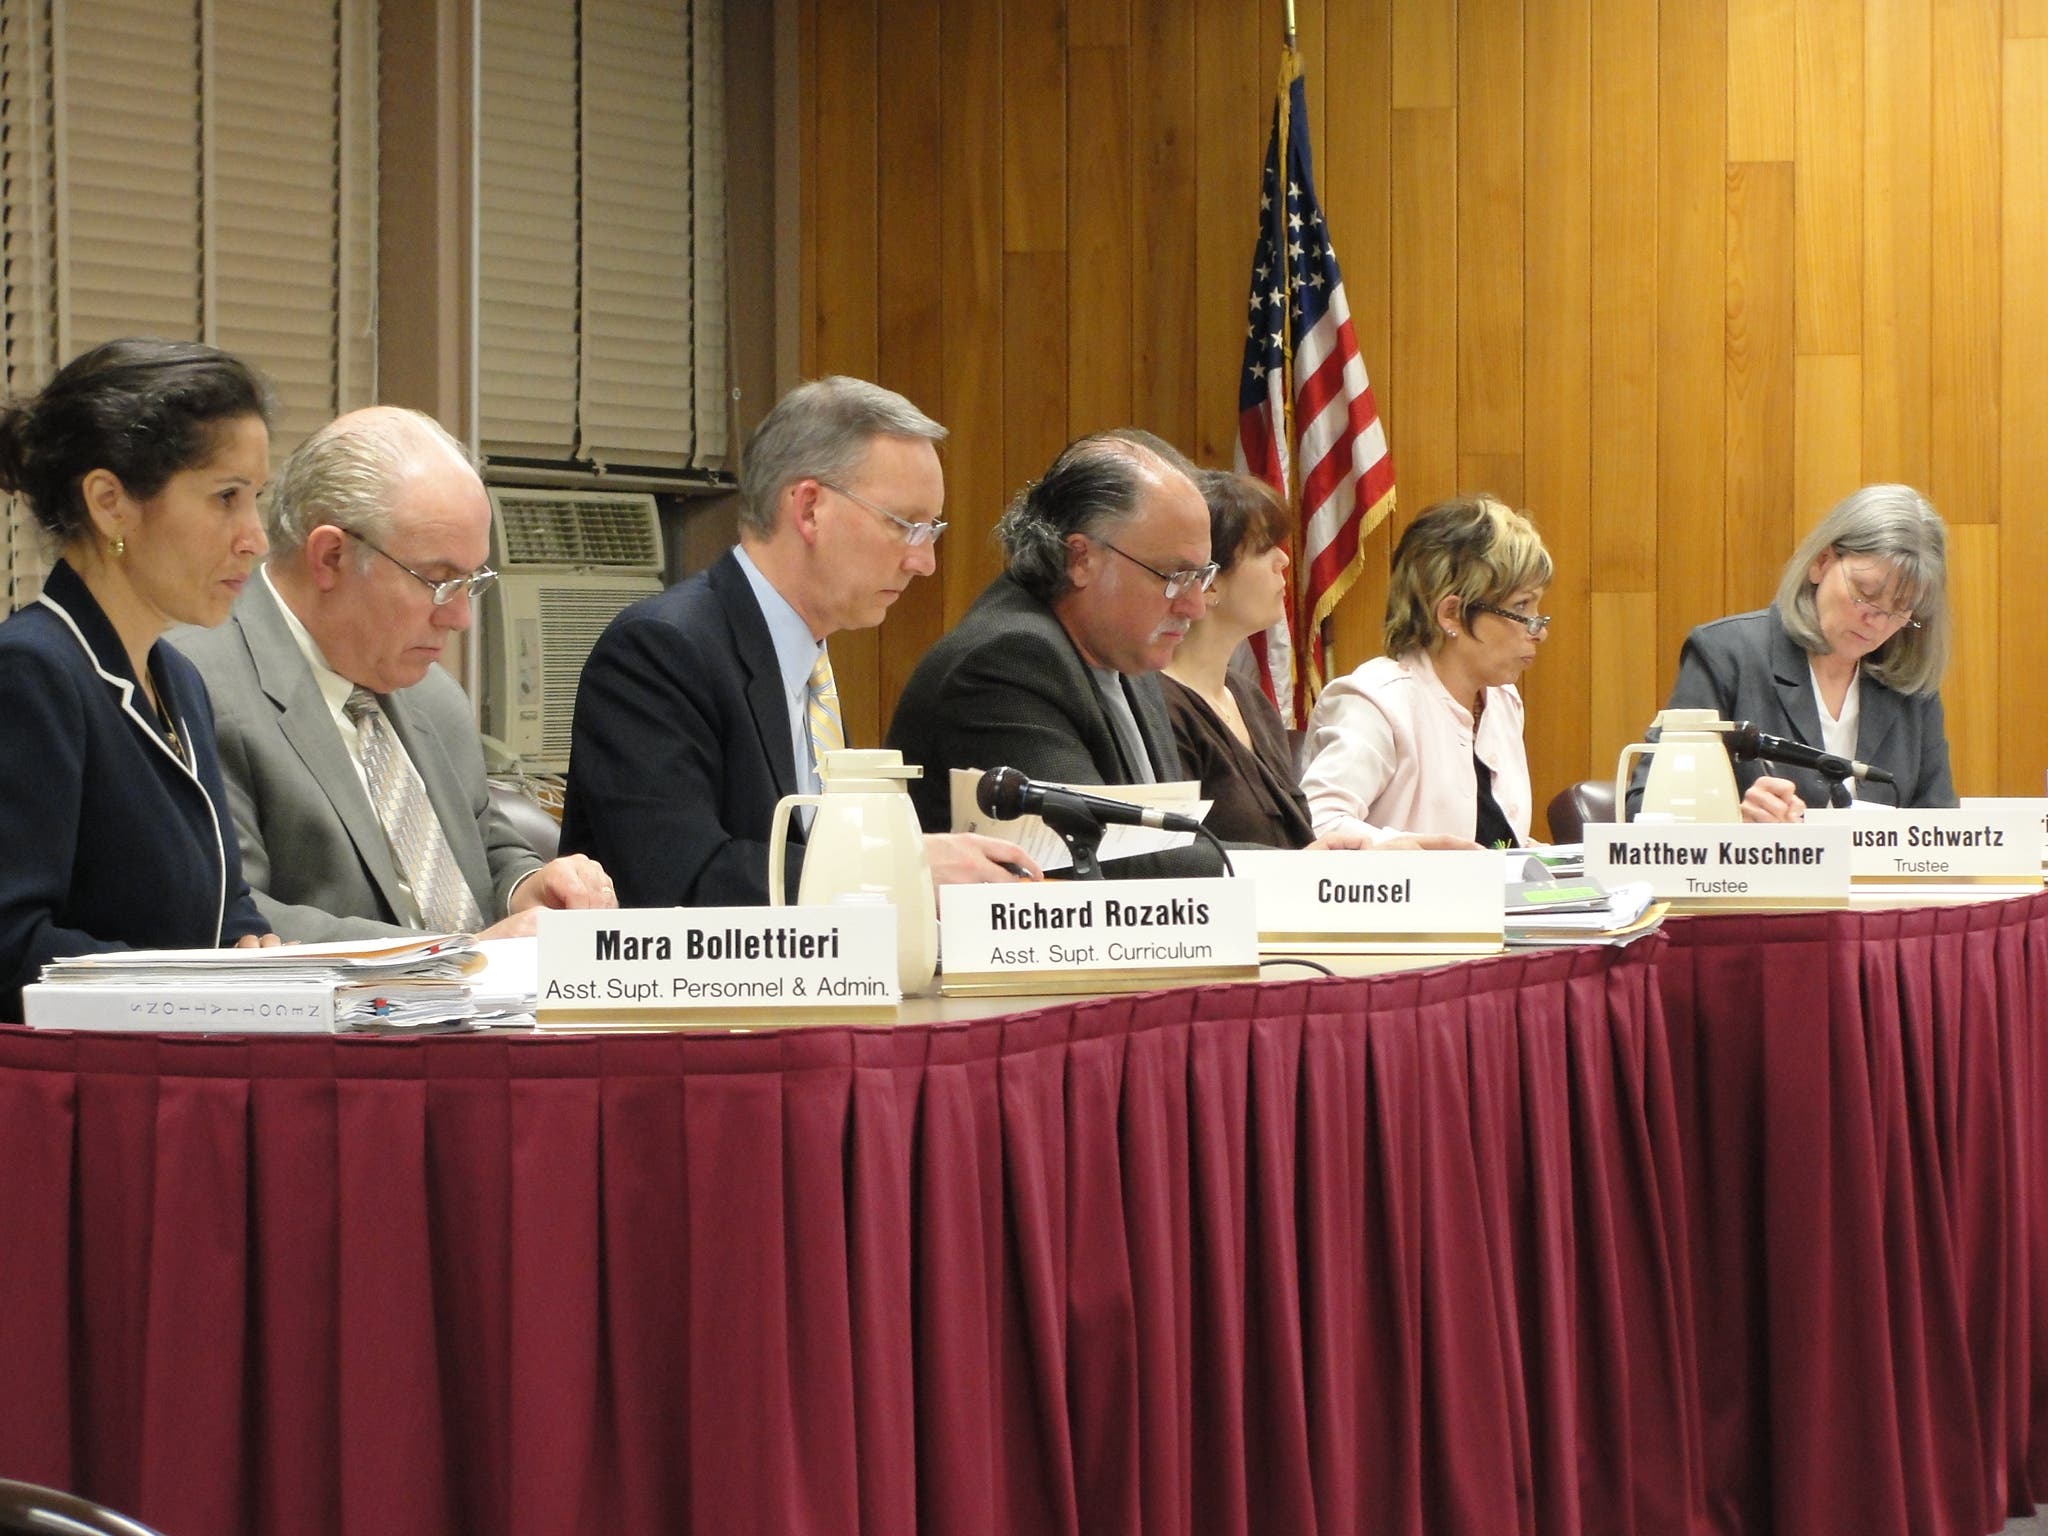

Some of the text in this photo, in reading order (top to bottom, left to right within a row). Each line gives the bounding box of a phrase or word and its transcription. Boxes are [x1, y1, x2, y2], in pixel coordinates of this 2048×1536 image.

[1852, 825, 2004, 847] usan Schwartz
[1609, 841, 1825, 866] Matthew Kuschner
[1893, 858, 1950, 873] Trustee
[1318, 878, 1412, 904] Counsel
[1685, 877, 1749, 893] Trustee
[991, 897, 1210, 931] Richard Rozakis
[596, 927, 840, 961] Mara Bollettieri
[990, 941, 1212, 966] Asst. Supt. Curriculum
[545, 976, 890, 1003] Asst. Supt. Personnel & Admin.
[130, 1002, 320, 1018] NEGOTIATIONS
